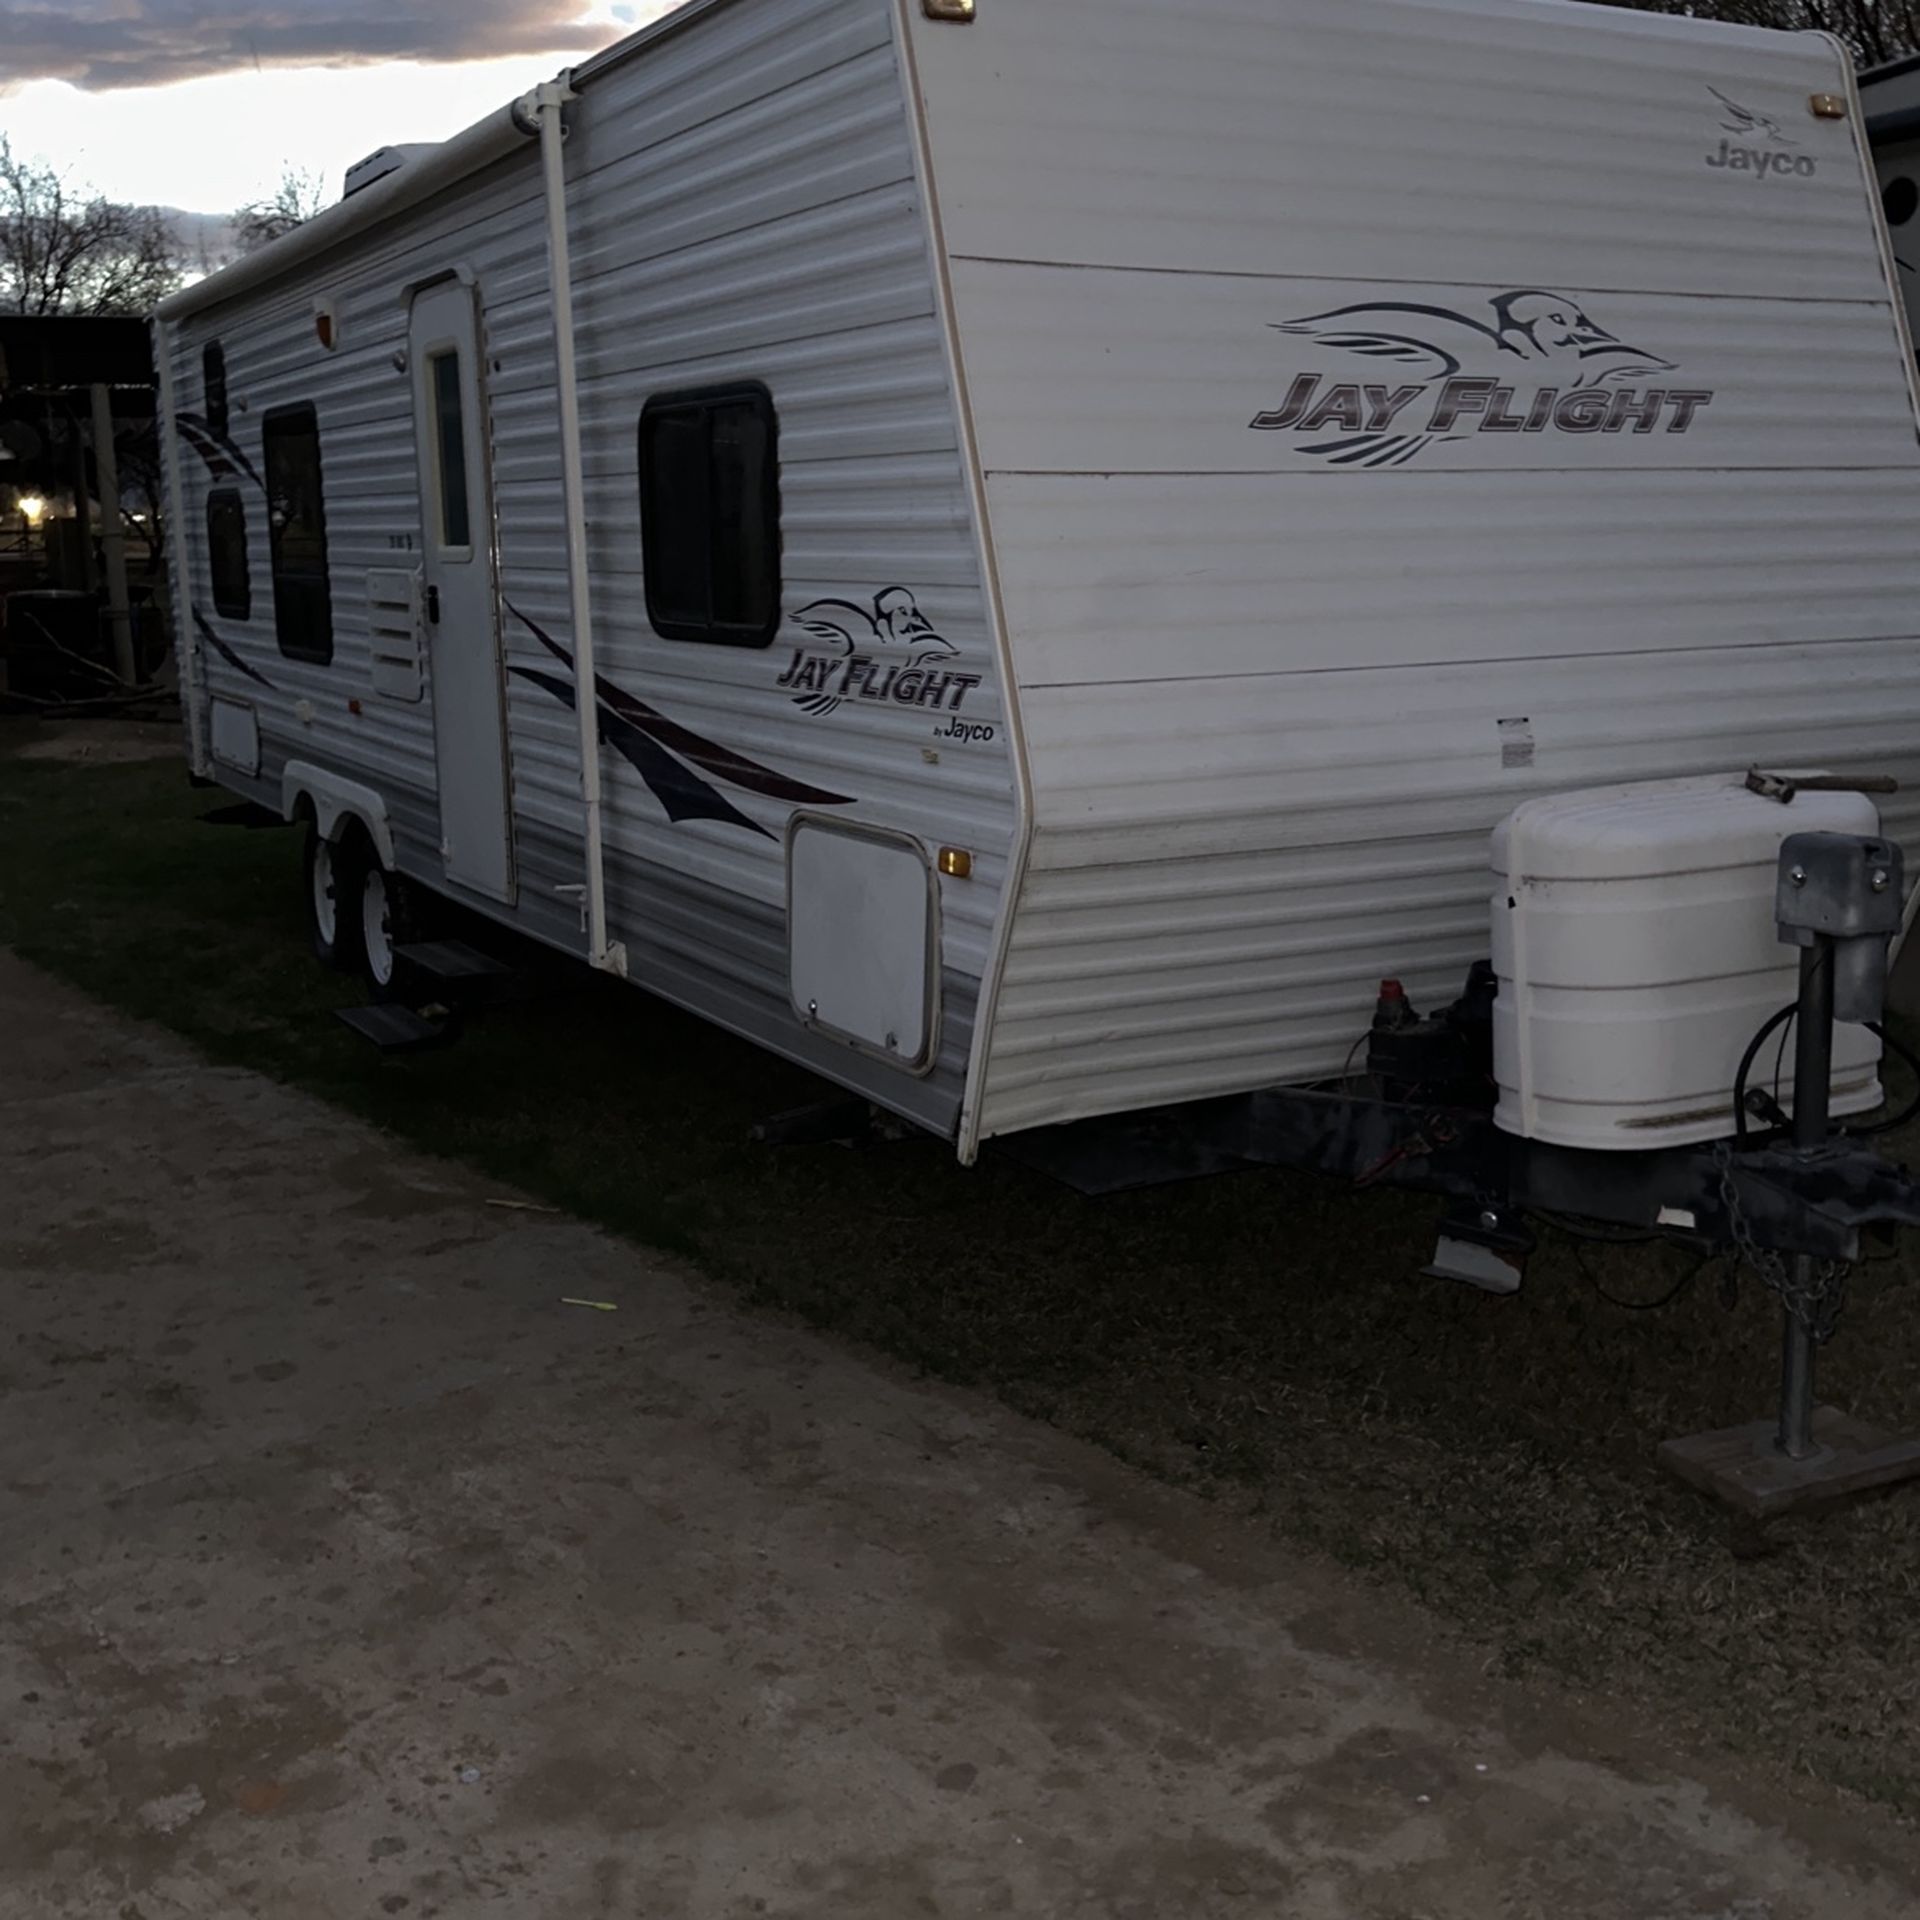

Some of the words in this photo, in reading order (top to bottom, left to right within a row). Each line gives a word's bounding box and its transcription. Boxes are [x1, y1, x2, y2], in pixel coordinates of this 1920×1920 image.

[1705, 138, 1816, 180] Jayco
[1248, 373, 1428, 431] JAY
[1426, 376, 1715, 434] FLIGHT
[776, 648, 842, 692] JAY
[838, 655, 983, 711] FLIGHT
[944, 716, 994, 744] Jayco
